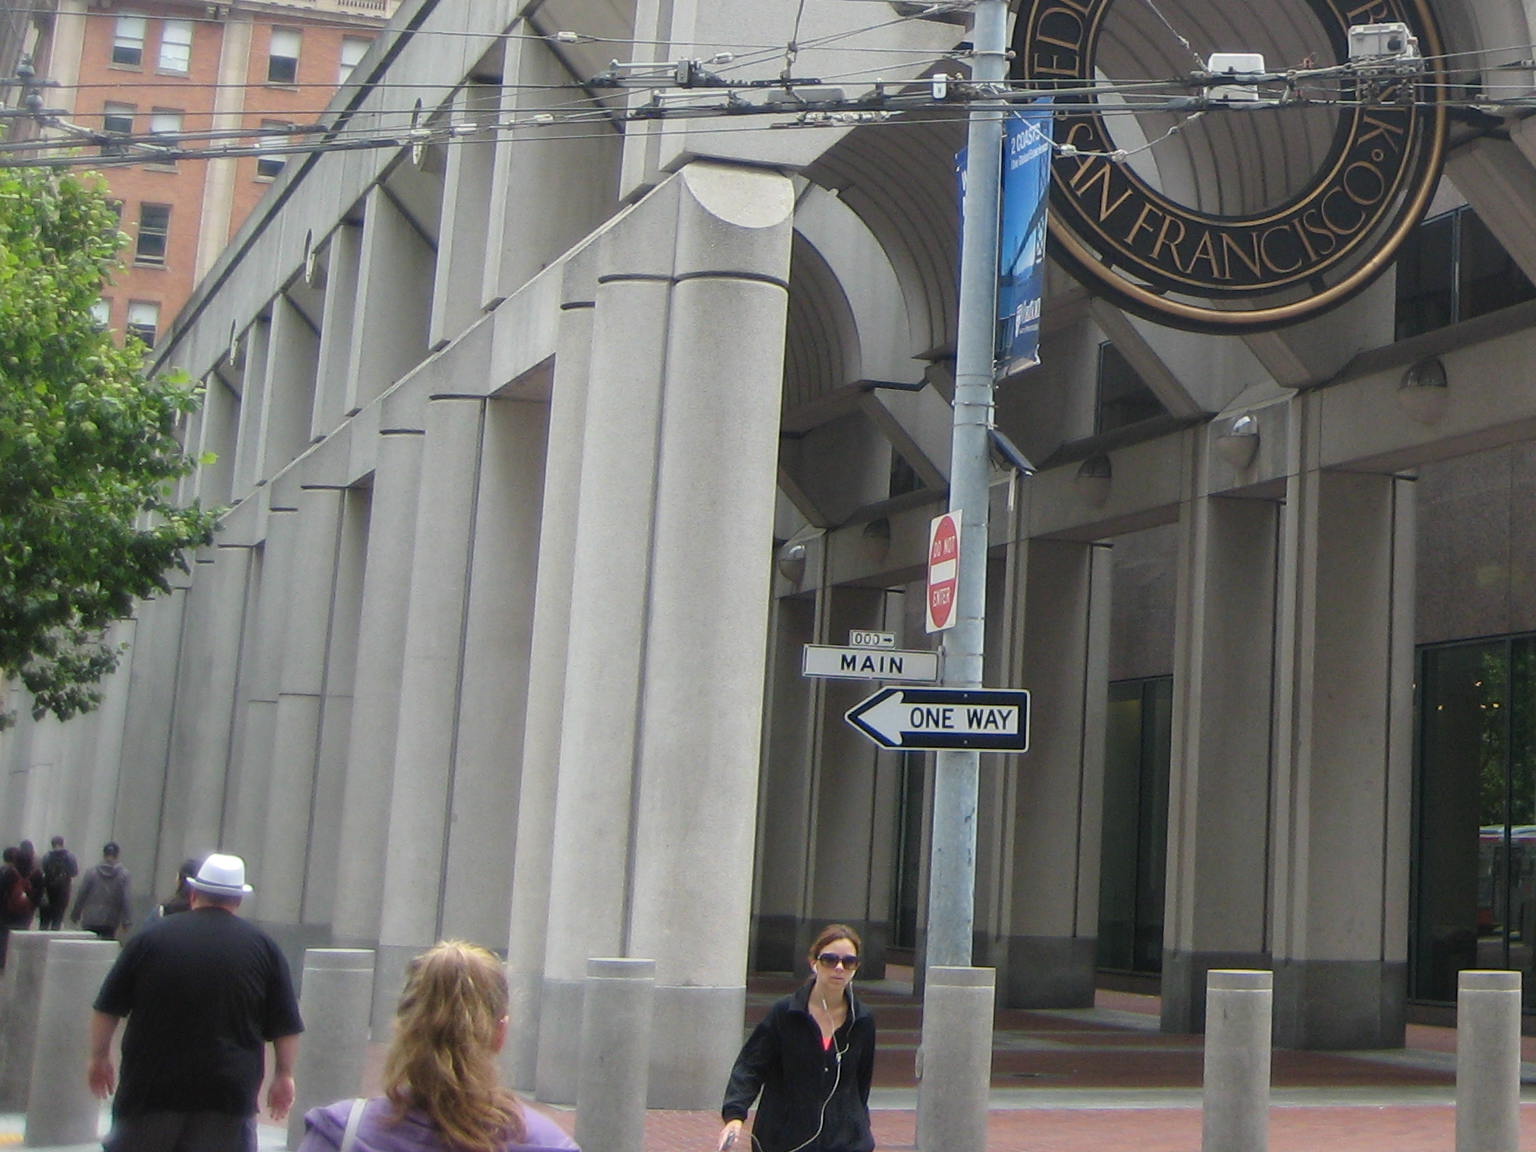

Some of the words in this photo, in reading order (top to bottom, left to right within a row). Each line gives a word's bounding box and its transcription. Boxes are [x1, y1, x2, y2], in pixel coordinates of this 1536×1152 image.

[1123, 160, 1385, 280] FRANCISCO
[932, 587, 951, 608] ENTER
[840, 654, 904, 674] MAIN
[910, 707, 954, 729] ONE
[966, 709, 1013, 730] WAY
